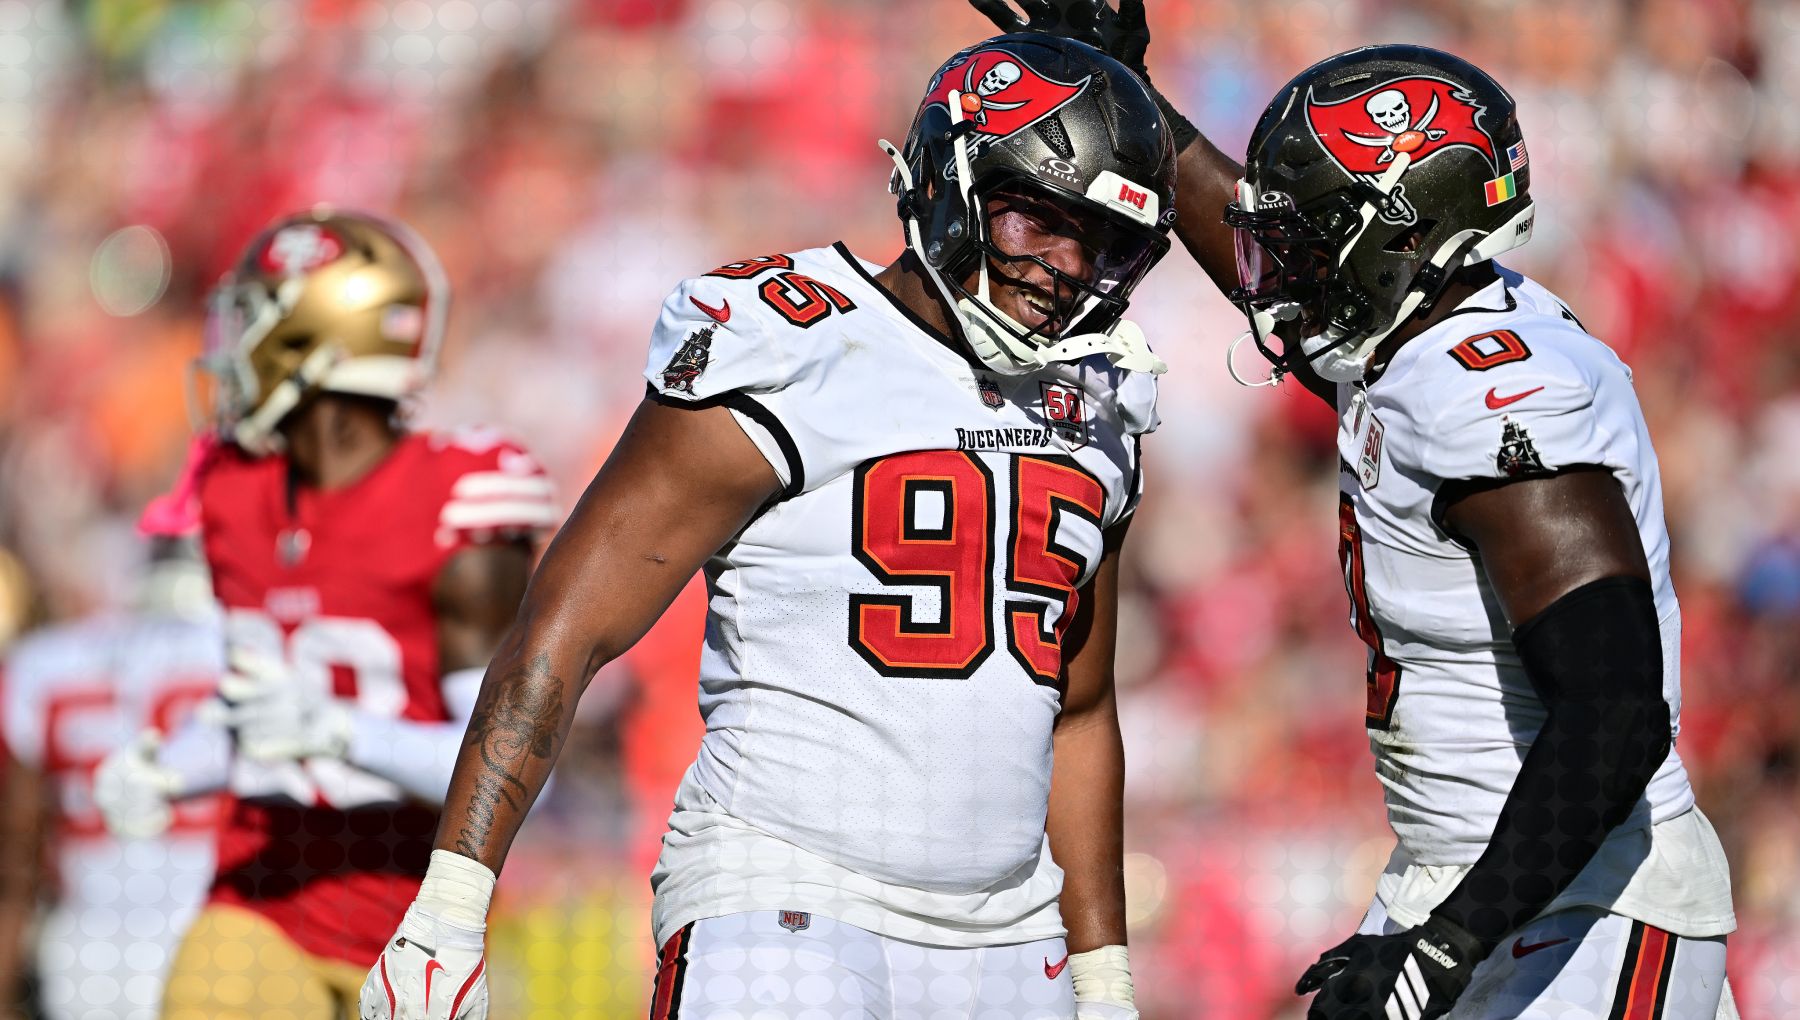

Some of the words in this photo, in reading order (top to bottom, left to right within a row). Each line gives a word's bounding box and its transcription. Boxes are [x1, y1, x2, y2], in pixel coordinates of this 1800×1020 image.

[1039, 165, 1080, 184] OAKLEY
[1258, 201, 1289, 210] OAKLEY
[1446, 329, 1533, 371] 0
[1046, 389, 1082, 425] 50
[1364, 422, 1381, 465] 50
[847, 449, 1107, 685] 95
[783, 911, 805, 926] NFL
[1416, 938, 1458, 969] ADIZERO
